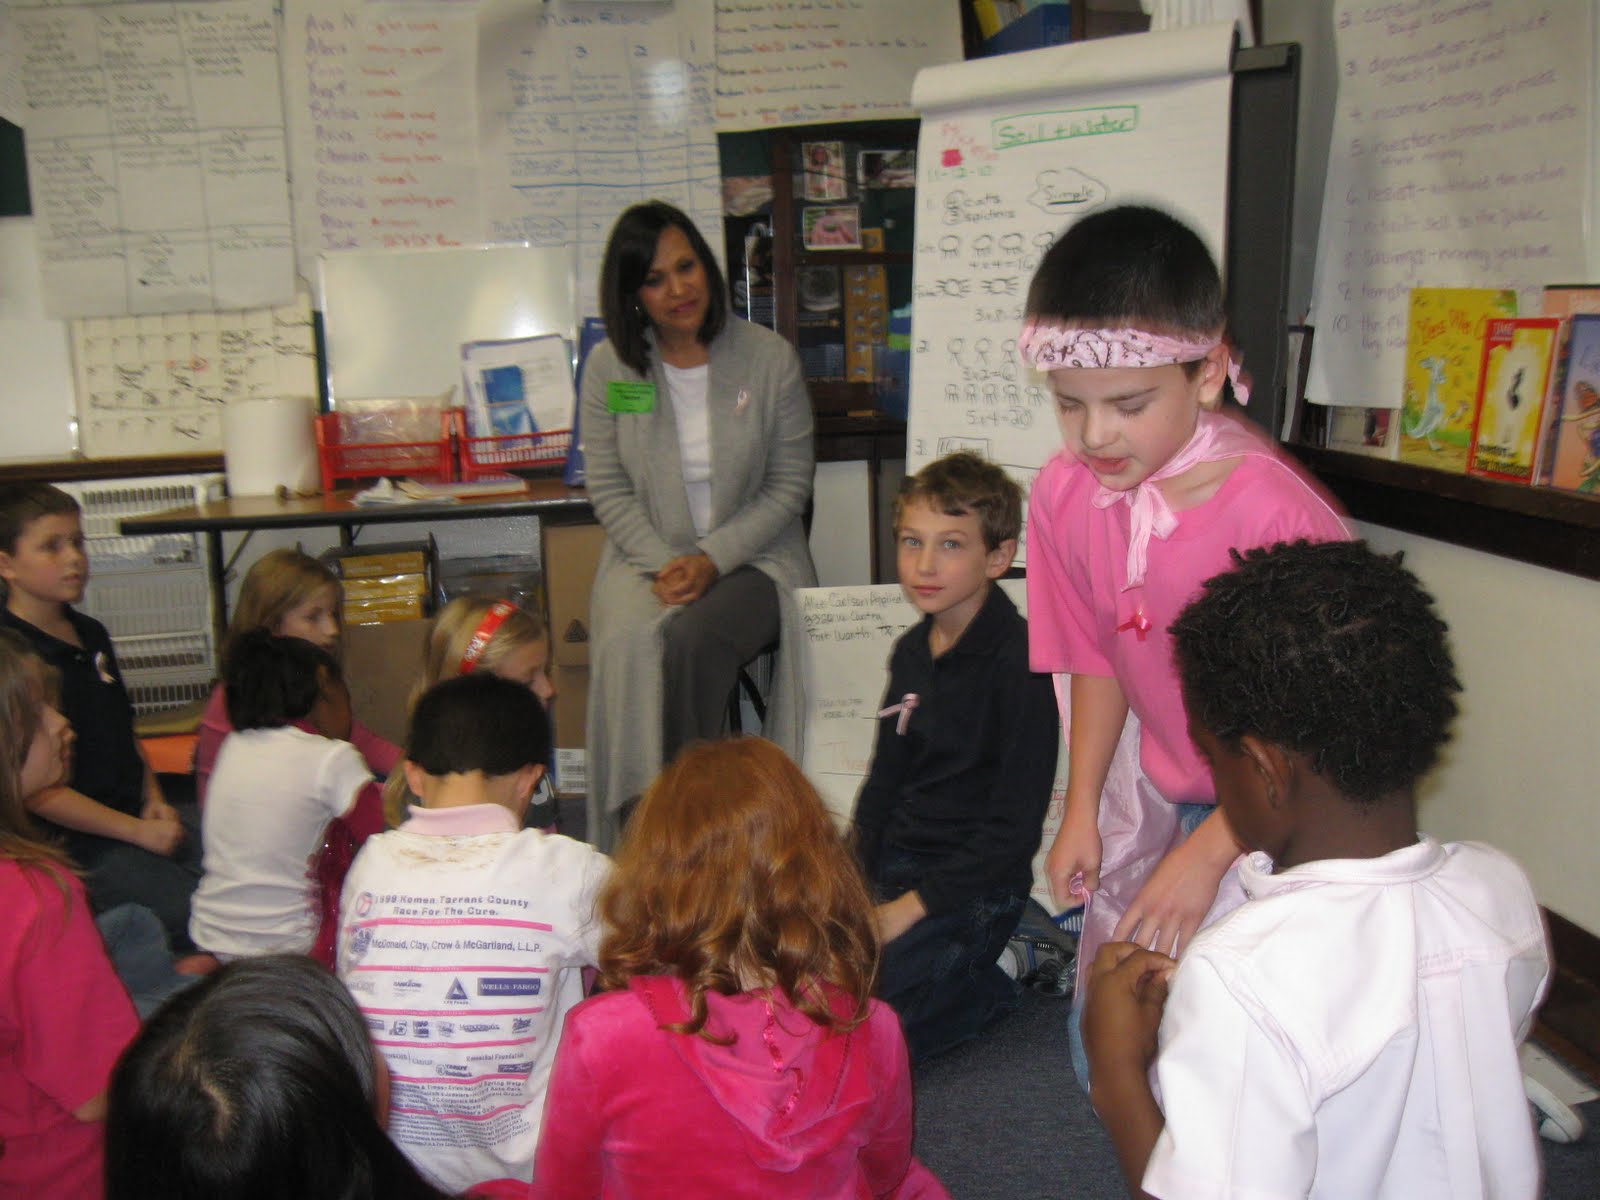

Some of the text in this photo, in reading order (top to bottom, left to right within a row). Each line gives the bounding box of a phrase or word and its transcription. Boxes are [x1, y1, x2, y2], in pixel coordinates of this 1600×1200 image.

[401, 895, 436, 904] Komen
[440, 895, 483, 904] Tarrant
[487, 895, 529, 909] County
[393, 907, 499, 916] Race For The Cure.
[410, 940, 428, 951] Clay,
[431, 940, 452, 950] Crow
[455, 941, 461, 950] &
[480, 983, 539, 991] WELLS FARGO
